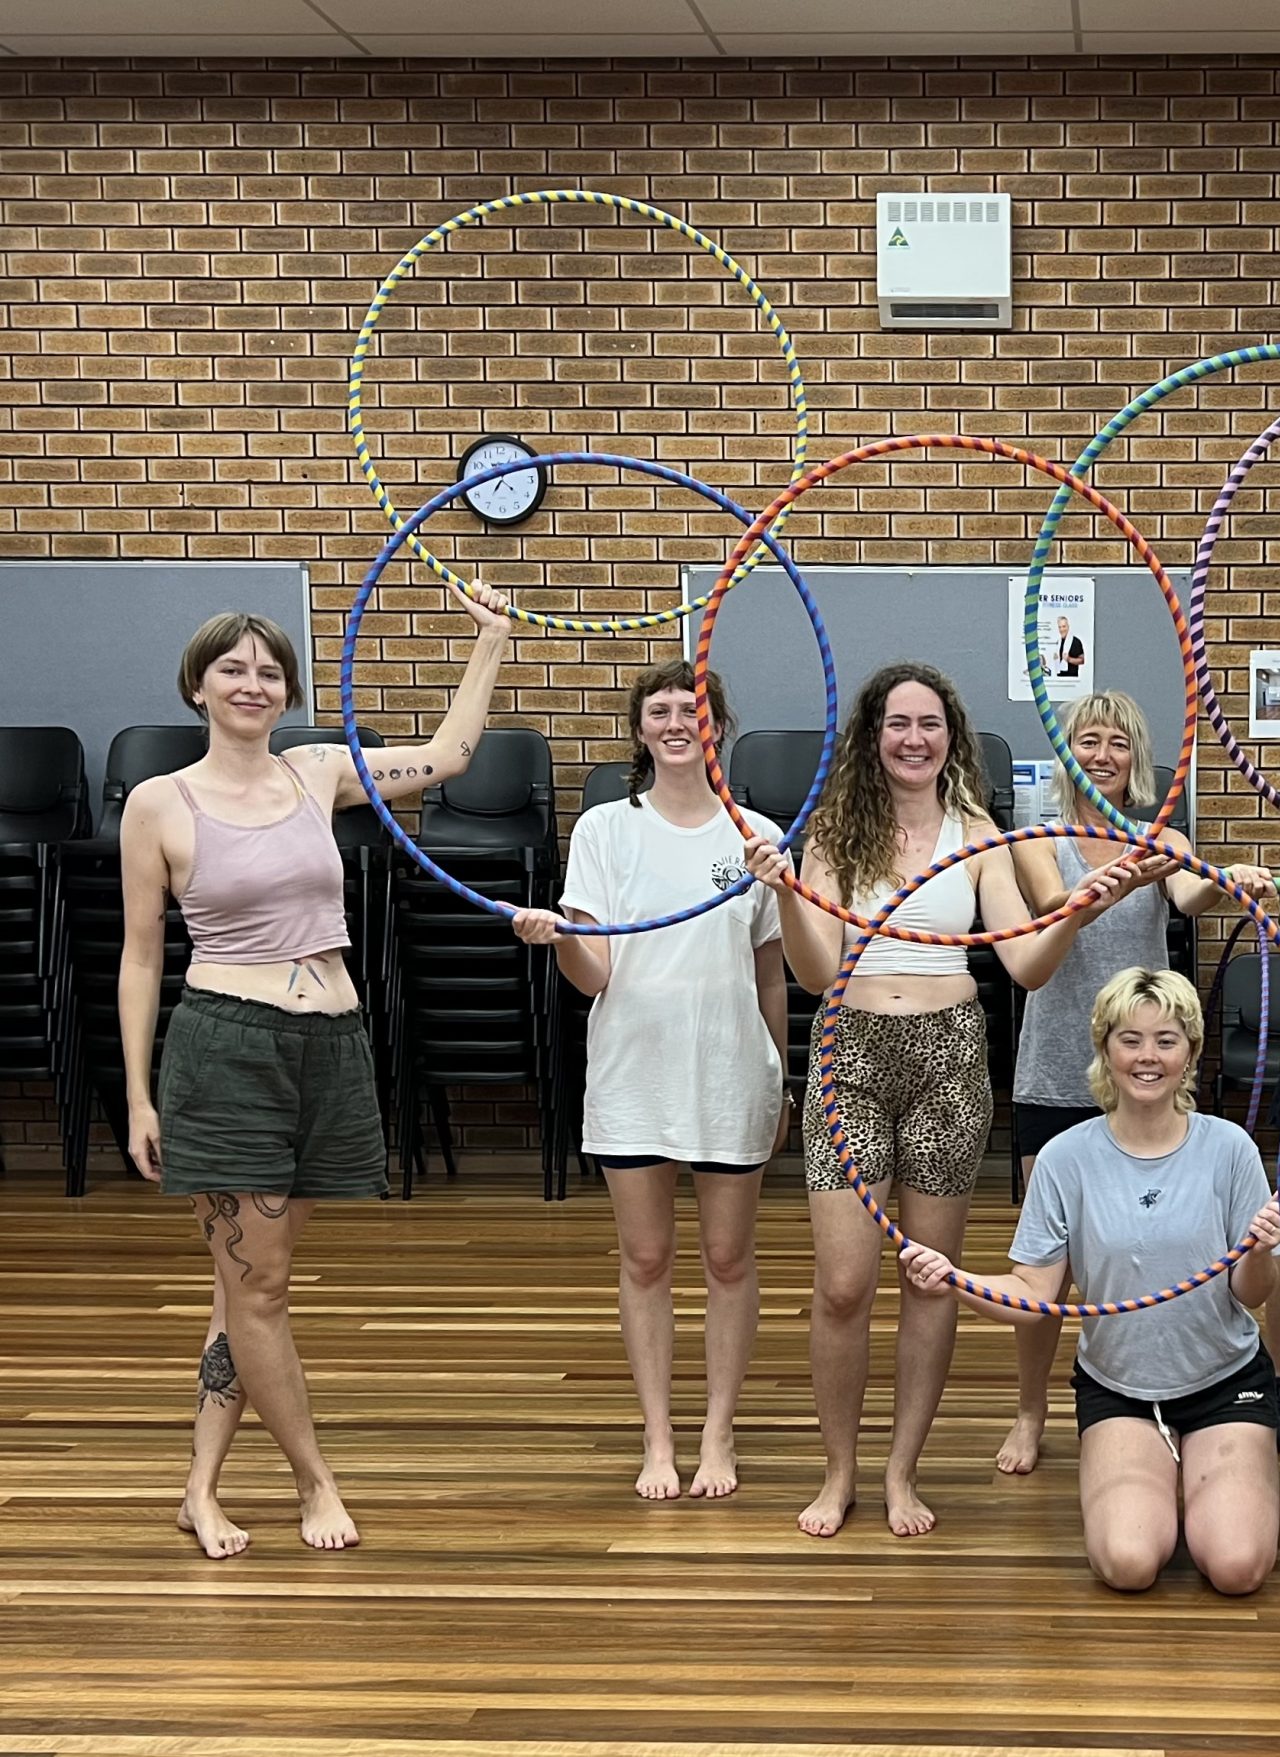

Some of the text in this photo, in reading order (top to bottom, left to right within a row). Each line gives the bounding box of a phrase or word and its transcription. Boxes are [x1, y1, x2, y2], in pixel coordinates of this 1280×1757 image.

[484, 450, 492, 459] 11
[496, 446, 506, 455] 12
[473, 461, 484, 470] 10
[528, 475, 534, 485] 3
[474, 491, 481, 499] 8
[485, 501, 492, 509] 7
[499, 505, 507, 514] 6
[513, 501, 520, 510] 5
[1051, 594, 1084, 603] SENIORS
